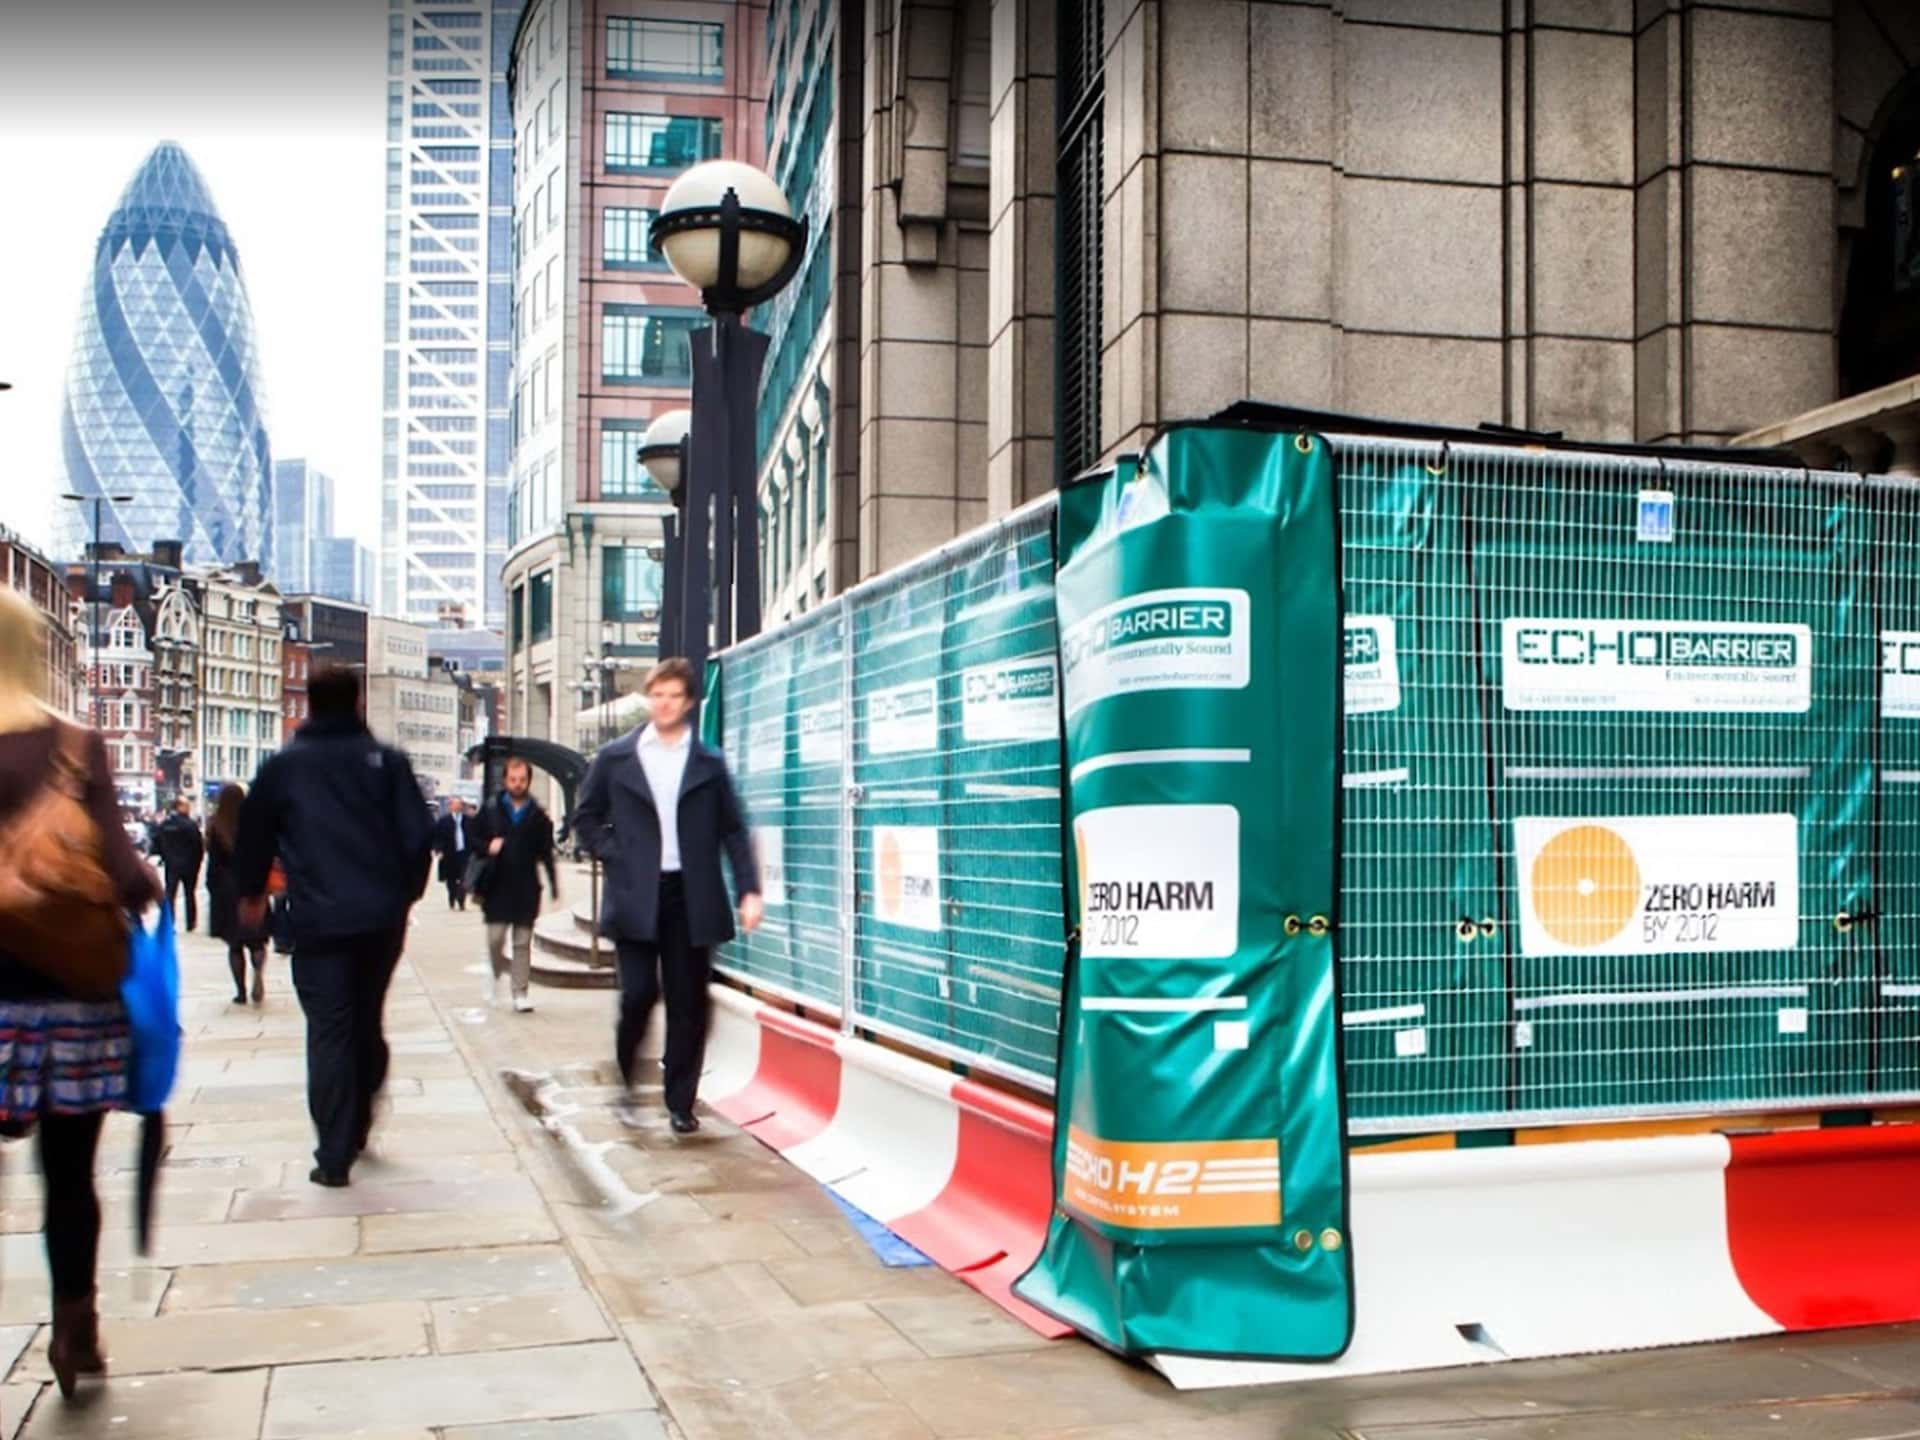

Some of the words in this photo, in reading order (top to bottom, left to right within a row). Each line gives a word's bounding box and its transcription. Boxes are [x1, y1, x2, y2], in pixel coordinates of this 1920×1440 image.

[1112, 606, 1224, 638] BARRIER
[1517, 629, 1662, 666] ECHO
[1672, 641, 1793, 661] BARRIER
[1126, 881, 1214, 911] HARM
[1644, 884, 1703, 912] ZERO
[1707, 882, 1776, 909] HARM
[1100, 914, 1140, 946] 2012
[1675, 914, 1718, 942] 2012
[1117, 1160, 1199, 1194] H2
